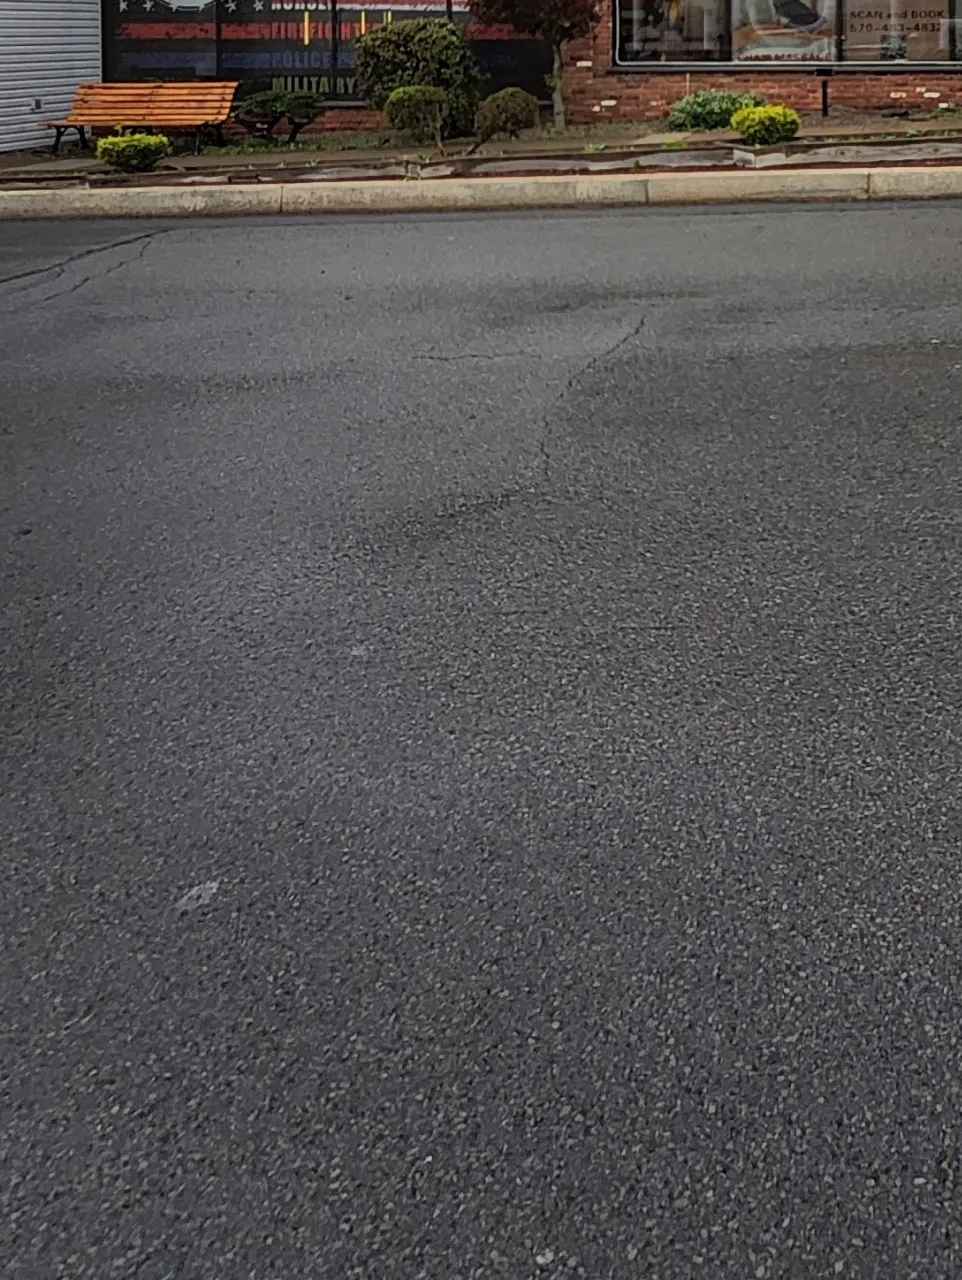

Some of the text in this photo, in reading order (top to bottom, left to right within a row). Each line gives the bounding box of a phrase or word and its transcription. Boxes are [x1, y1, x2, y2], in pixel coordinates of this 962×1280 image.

[850, 10, 882, 19] SCAN
[911, 10, 944, 19] BOOK
[271, 52, 331, 69] POLICE
[272, 76, 356, 94] MILITARY
